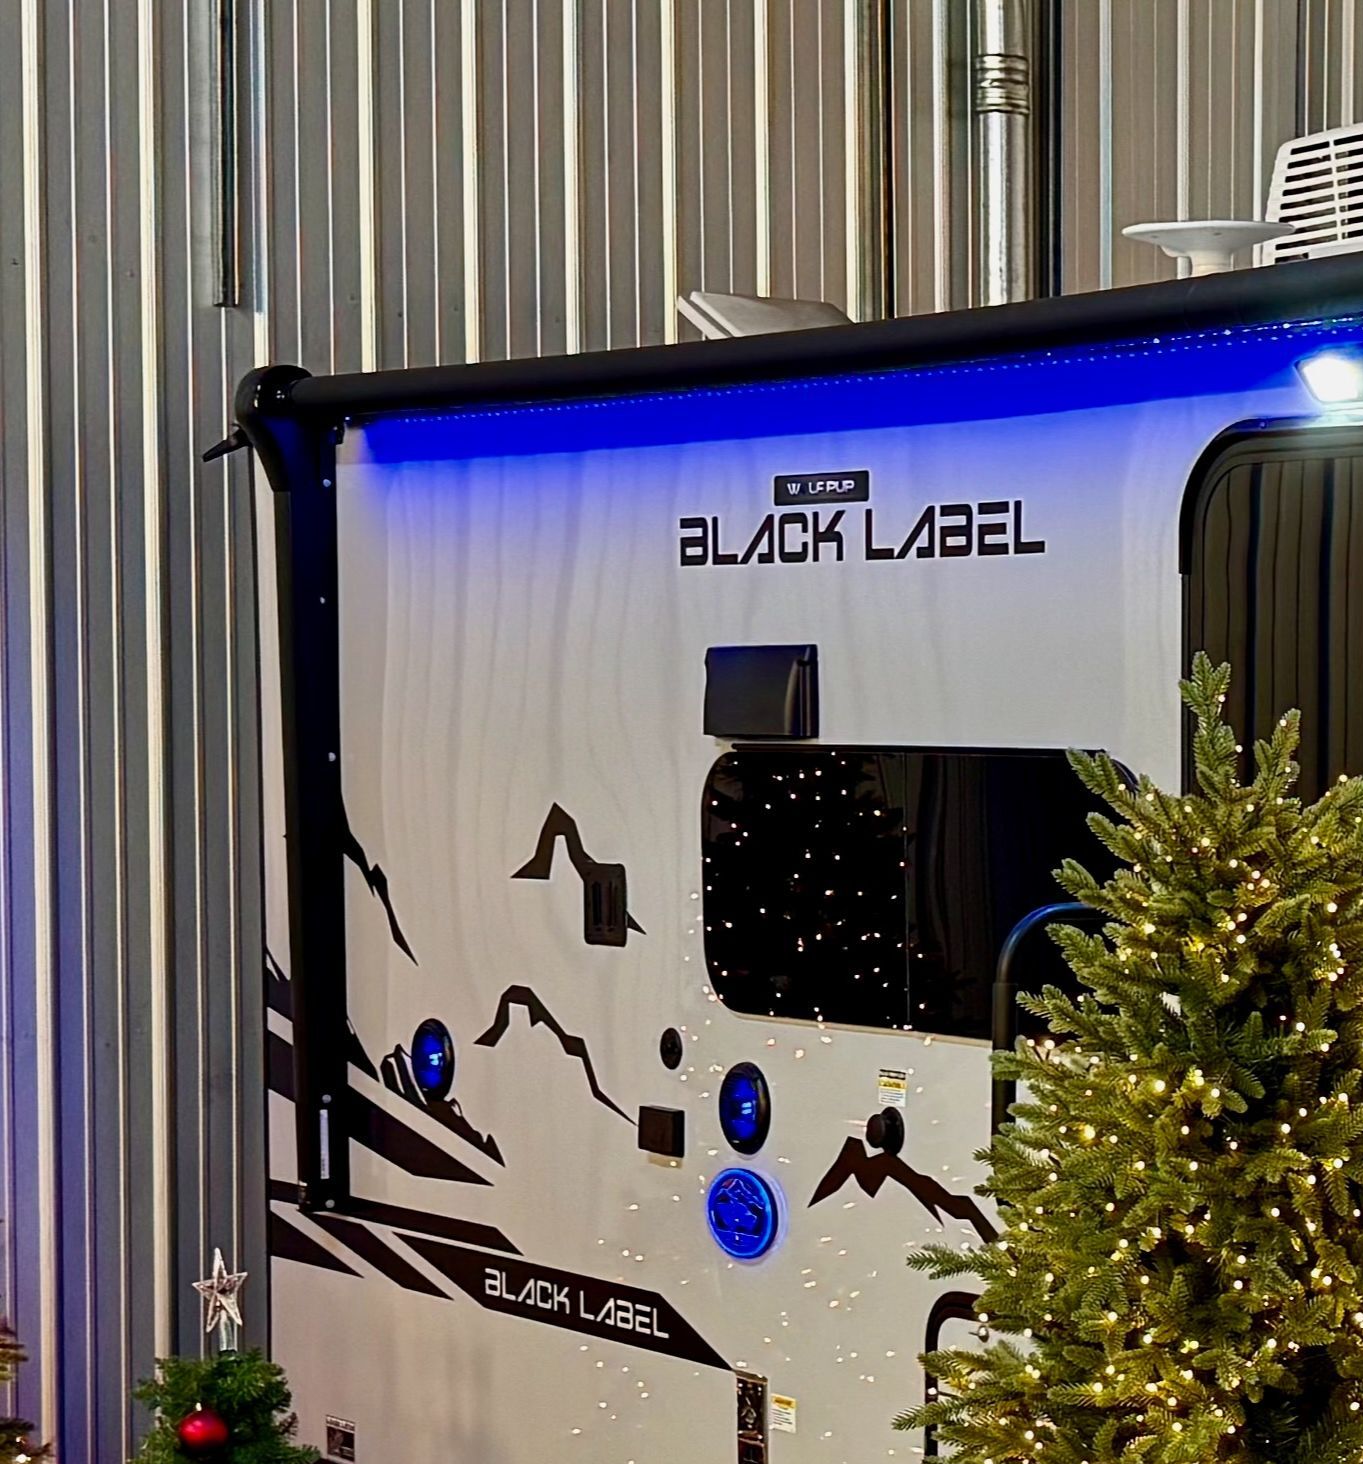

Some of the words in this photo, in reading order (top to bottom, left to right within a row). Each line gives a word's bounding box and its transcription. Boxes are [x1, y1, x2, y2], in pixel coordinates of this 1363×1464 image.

[786, 480, 855, 496] WLFPUP
[679, 509, 846, 567] BLACK
[864, 499, 1046, 561] LABEL
[484, 1267, 571, 1315] BLACK
[579, 1290, 670, 1339] LABEL
